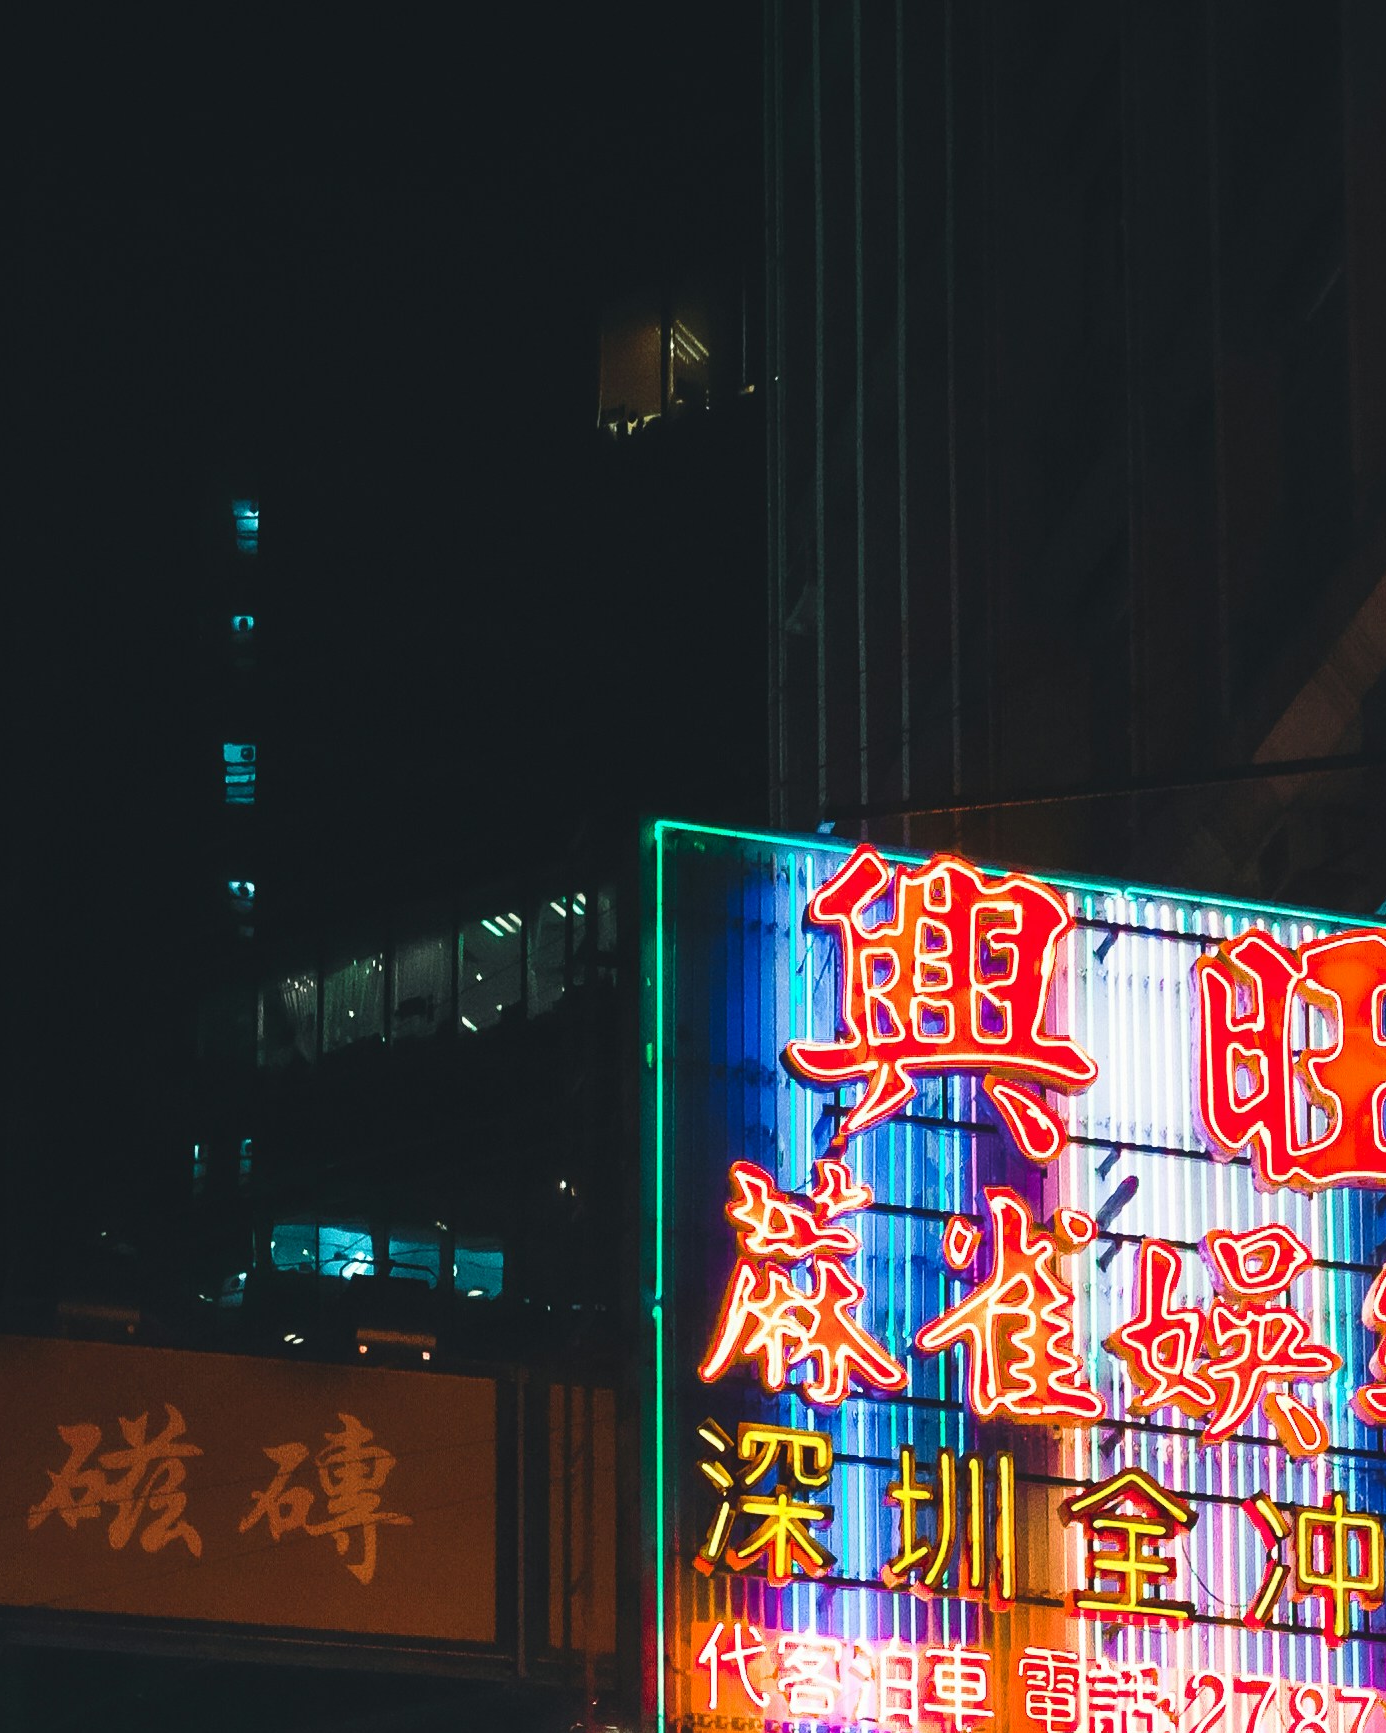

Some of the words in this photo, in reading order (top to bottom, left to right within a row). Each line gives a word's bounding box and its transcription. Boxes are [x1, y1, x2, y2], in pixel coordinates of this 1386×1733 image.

[29, 1404, 412, 1585] 磁磚
[698, 1621, 995, 1732] 代客泊車
